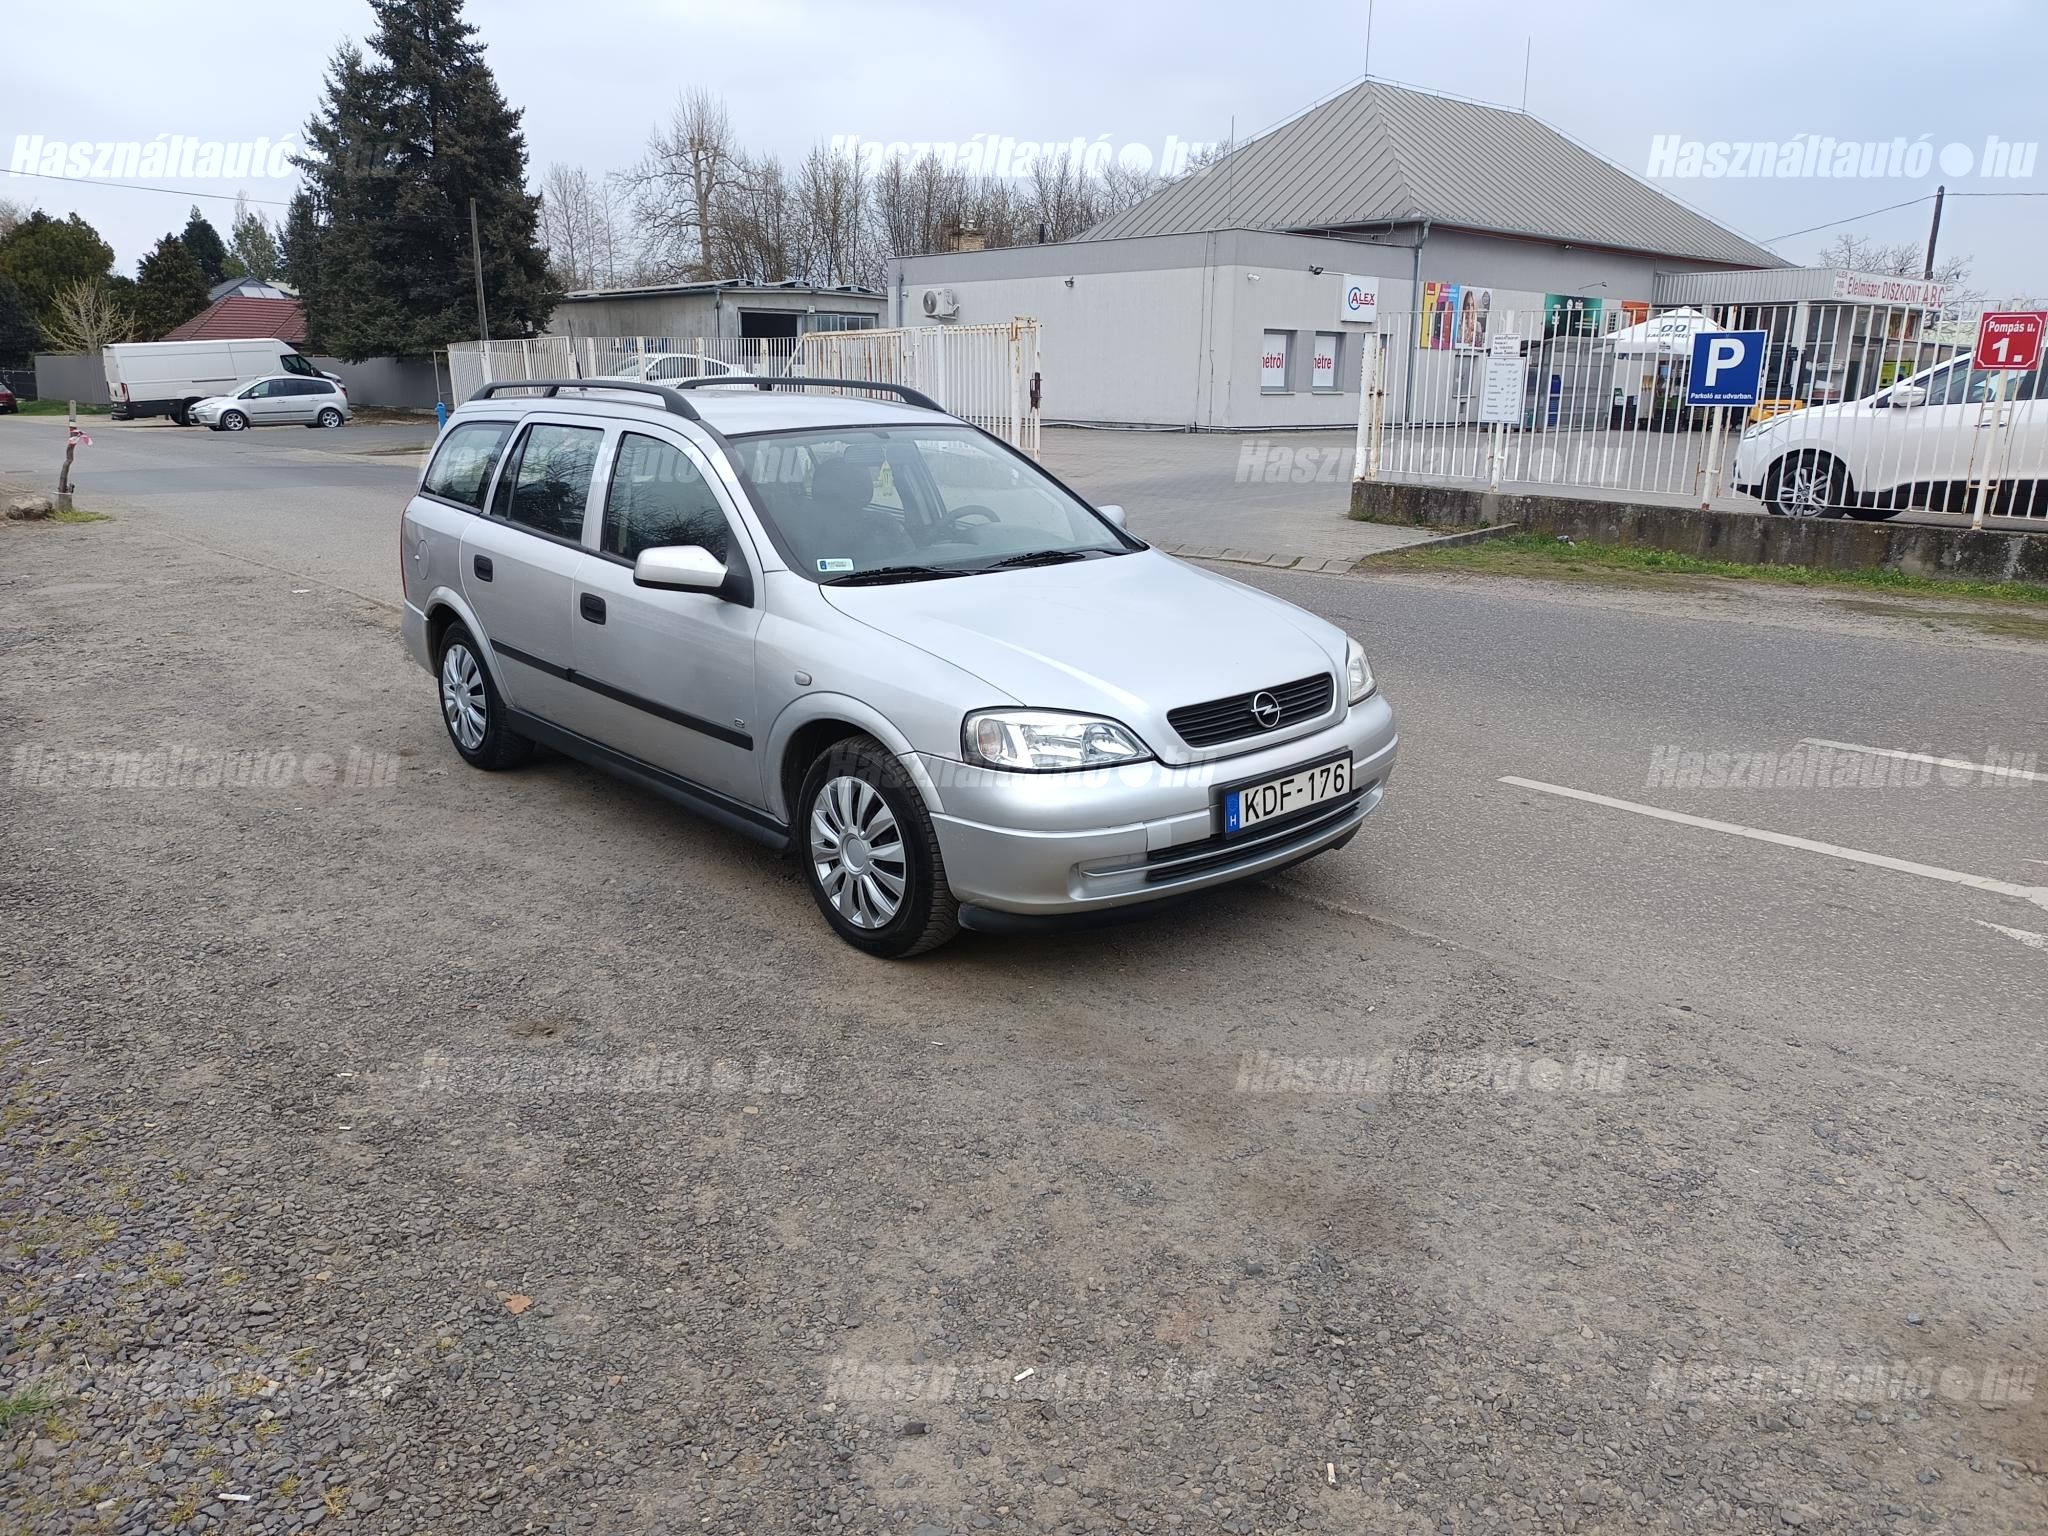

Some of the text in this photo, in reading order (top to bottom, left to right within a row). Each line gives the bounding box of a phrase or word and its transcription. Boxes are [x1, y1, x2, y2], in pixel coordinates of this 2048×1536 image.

[1881, 281, 1920, 304] DISZKONT
[1988, 320, 2036, 336] Pompás u.
[1705, 338, 1745, 386] P
[1992, 337, 2023, 363] 1.
[1722, 392, 1753, 400] udvarban.
[1230, 763, 1345, 827] H KDF-176
